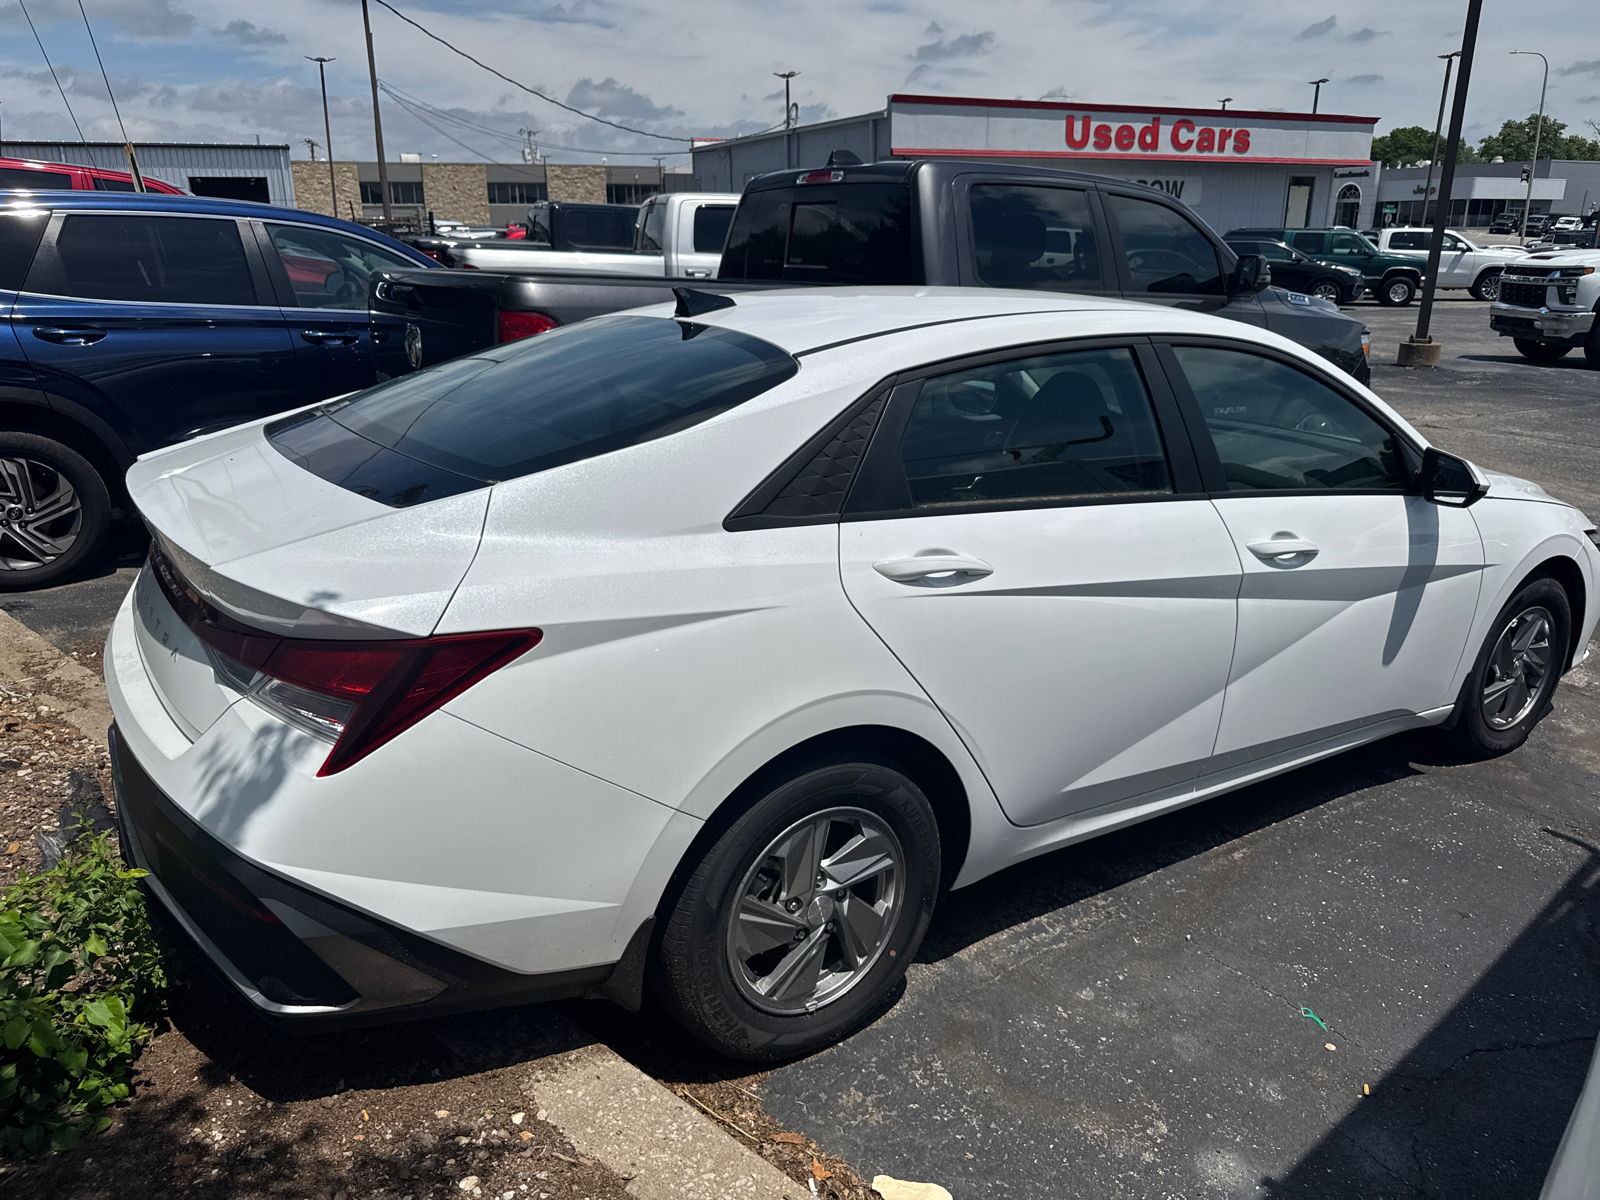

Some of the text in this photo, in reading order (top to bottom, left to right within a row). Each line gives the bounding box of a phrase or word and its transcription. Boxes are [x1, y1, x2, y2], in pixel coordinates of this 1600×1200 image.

[1065, 115, 1250, 153] Used Cars
[1412, 185, 1436, 196] Jep
